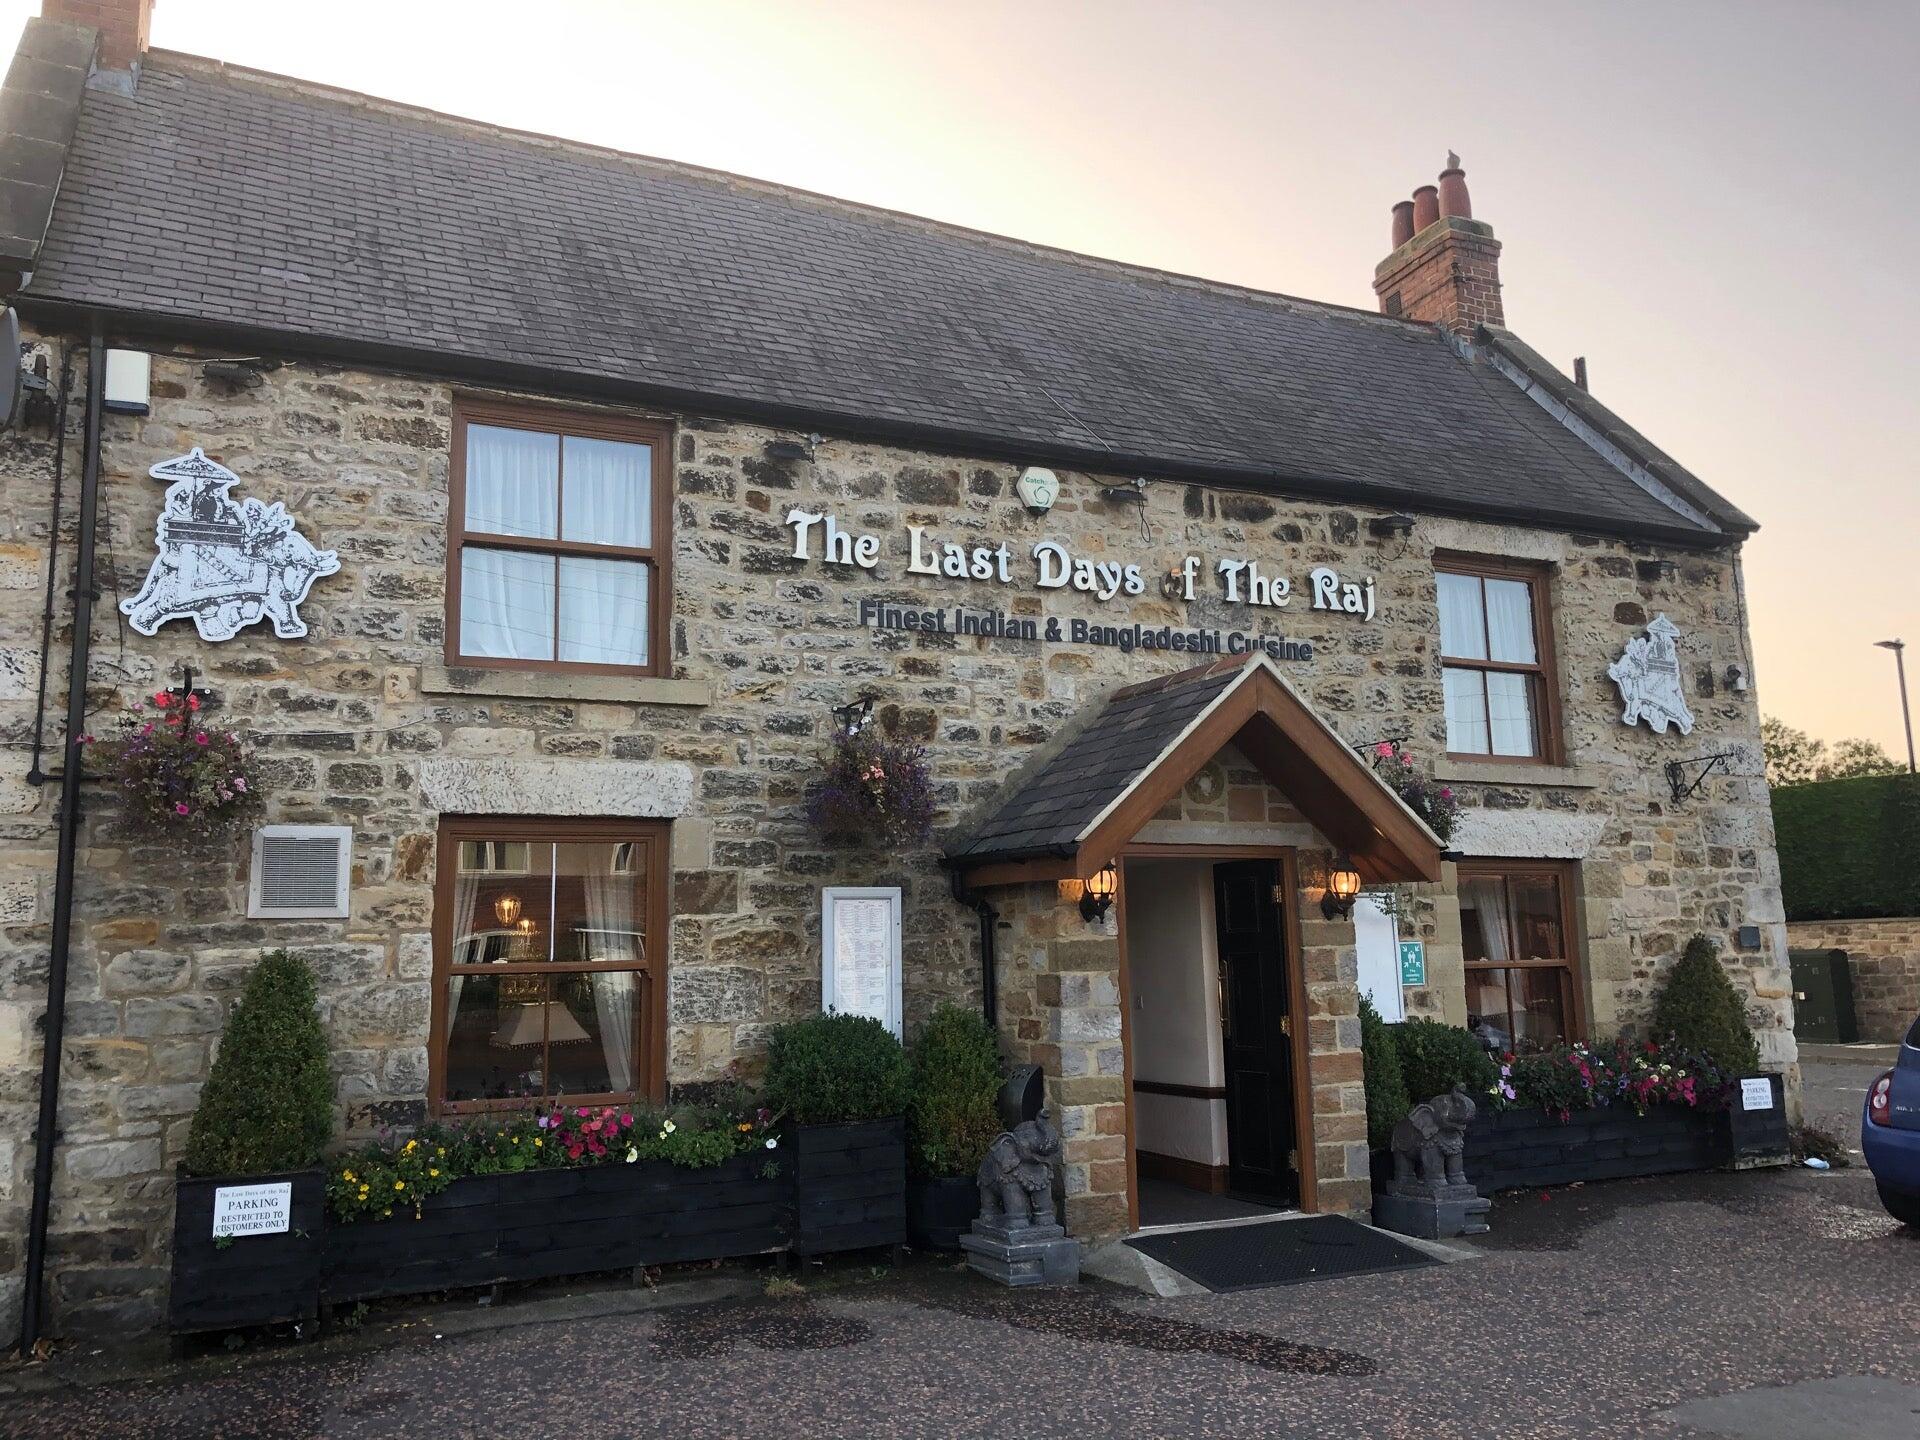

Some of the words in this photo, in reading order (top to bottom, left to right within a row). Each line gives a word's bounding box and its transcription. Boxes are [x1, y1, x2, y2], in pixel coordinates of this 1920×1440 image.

[1025, 476, 1045, 485] Catch
[785, 509, 881, 568] The
[906, 524, 1014, 583] Last
[1032, 541, 1145, 601] Days
[1218, 558, 1291, 607] The
[1310, 567, 1376, 622] Raj
[860, 600, 947, 633] Finest
[955, 608, 1038, 640] Indian
[1044, 616, 1063, 642] &
[1070, 618, 1221, 653] Bangladeshi
[1227, 631, 1313, 661] Cuisine
[228, 1198, 278, 1210] PARKING
[221, 1212, 270, 1223] RESTRICTED
[273, 1211, 283, 1219] TO
[216, 1222, 263, 1232] CUSTOMERS
[265, 1220, 287, 1228] ONLY
